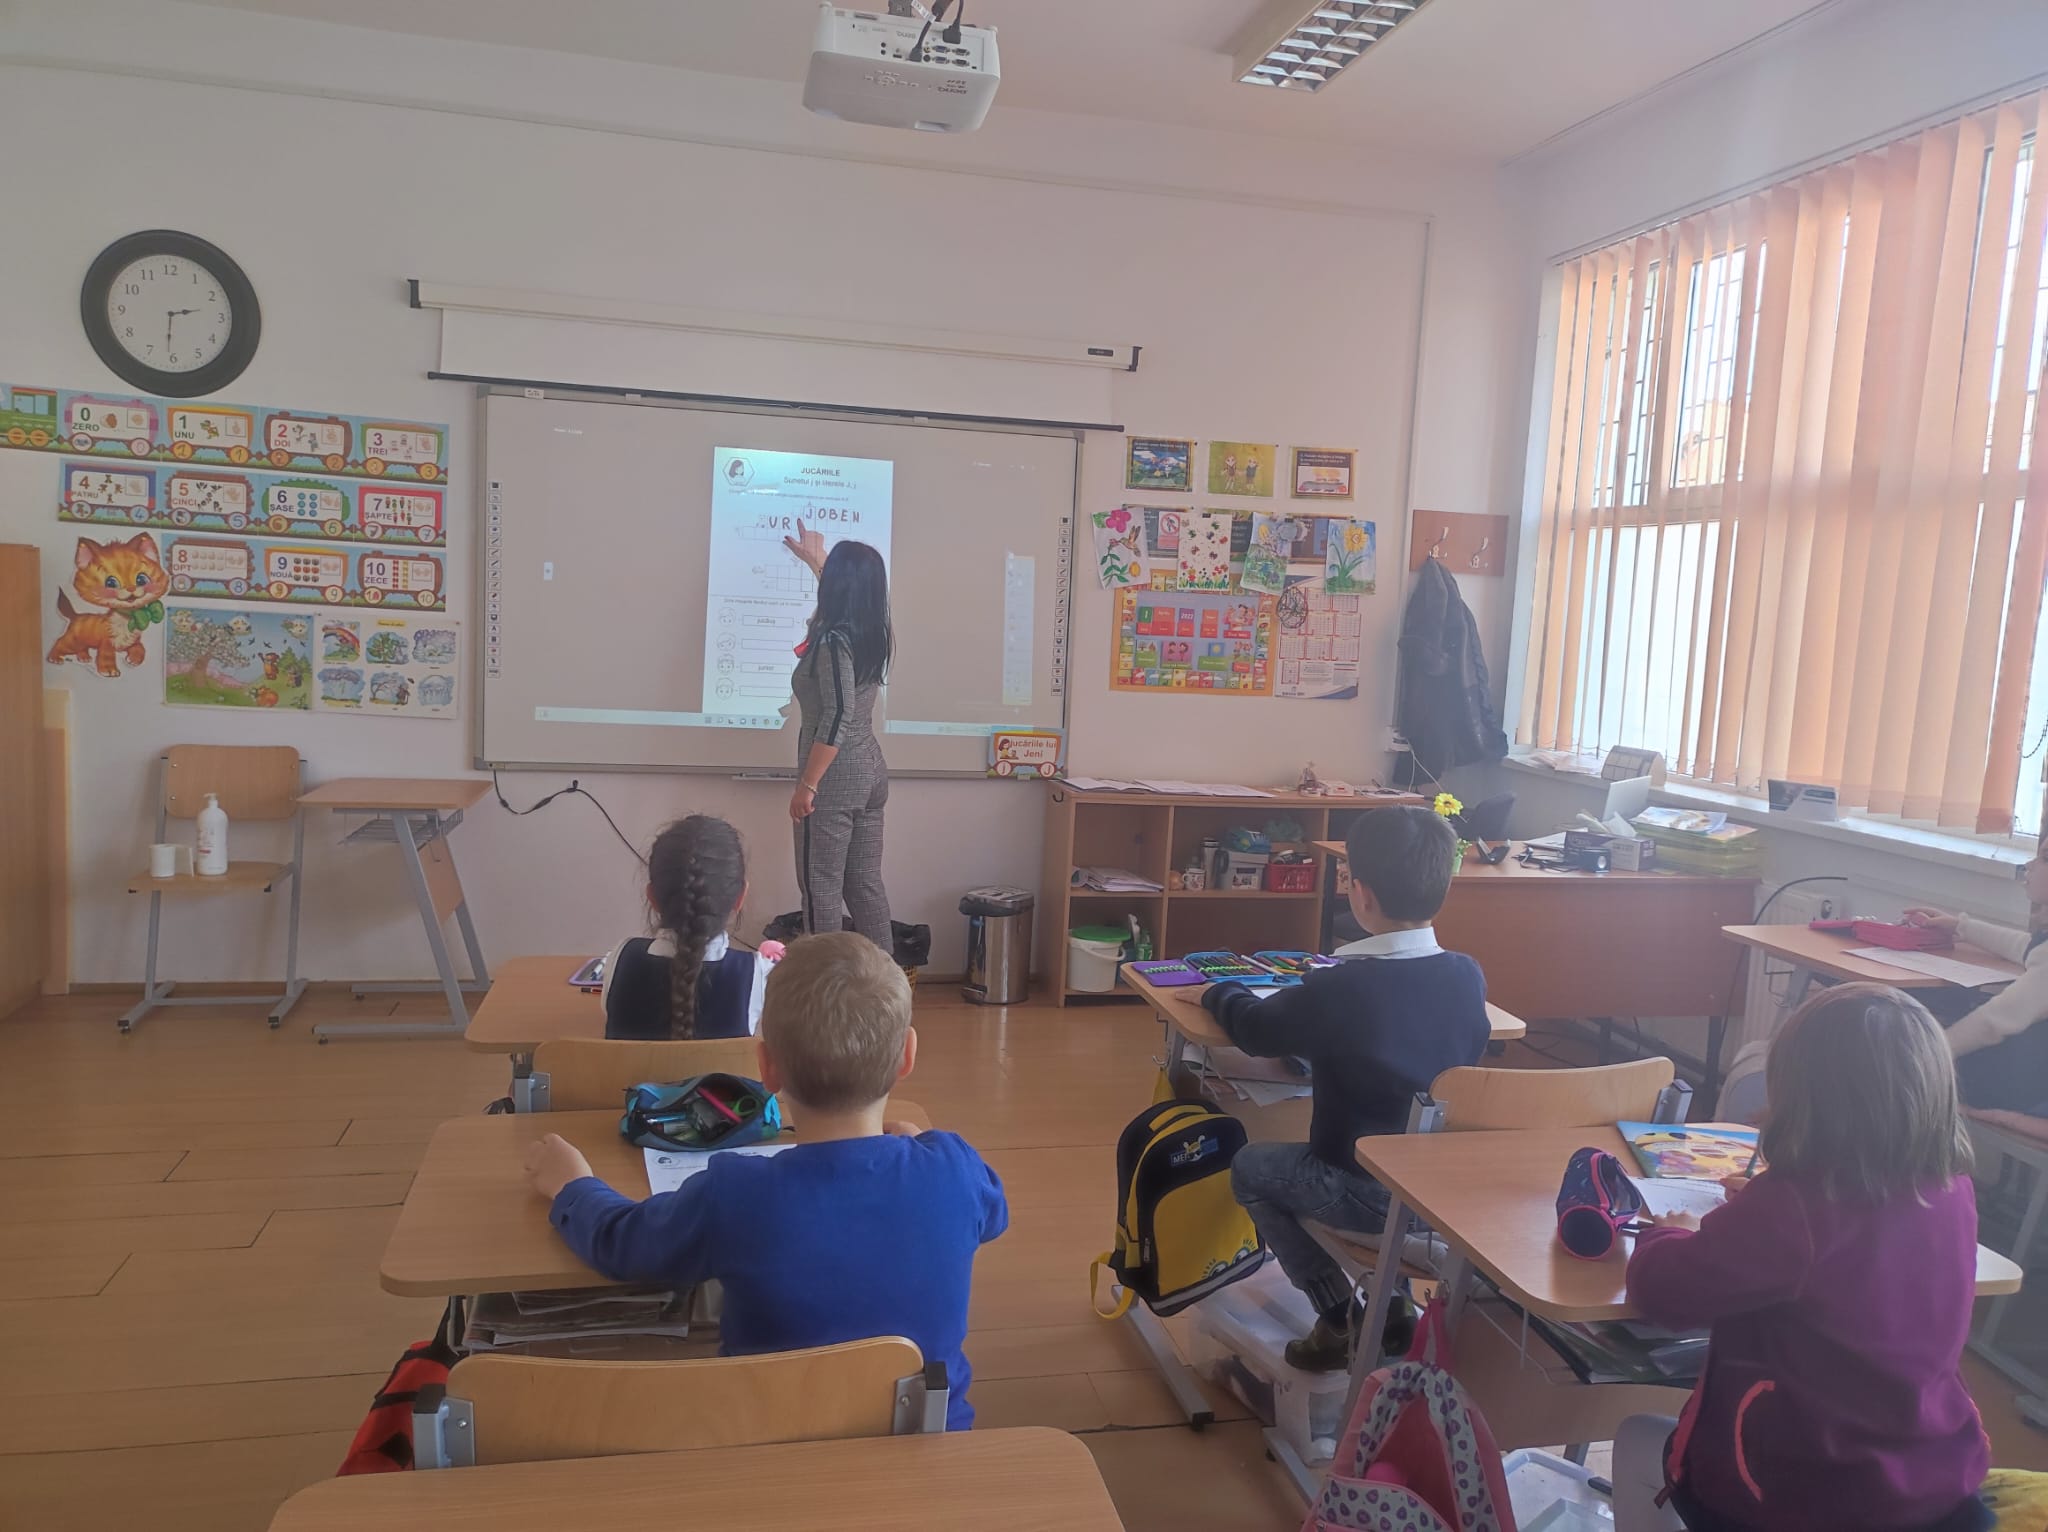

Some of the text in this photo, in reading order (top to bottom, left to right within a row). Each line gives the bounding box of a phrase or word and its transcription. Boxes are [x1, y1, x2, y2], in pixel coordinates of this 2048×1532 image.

[141, 270, 154, 280] 11
[164, 264, 178, 276] 12
[192, 274, 198, 284] 1
[126, 285, 139, 295] 10
[208, 291, 216, 301] 2
[118, 305, 126, 315] 9
[218, 312, 225, 323] 3
[126, 327, 134, 338] 8
[208, 333, 216, 344] 4
[146, 345, 154, 355] 7
[195, 348, 202, 359] 5
[170, 353, 178, 364] 6
[80, 408, 90, 421] 0
[72, 422, 100, 432] ZERO
[179, 414, 186, 429] 1
[174, 431, 194, 439] UNU
[278, 424, 288, 438] 2
[374, 432, 383, 446] 3
[368, 447, 387, 456] TREI
[79, 475, 90, 490] 4
[179, 483, 189, 496] 5
[277, 490, 287, 503] 6
[373, 498, 383, 511] 7
[179, 550, 187, 563] 8
[278, 556, 287, 570] 9
[367, 562, 385, 576] 10
[1024, 750, 1043, 758] Jeni
